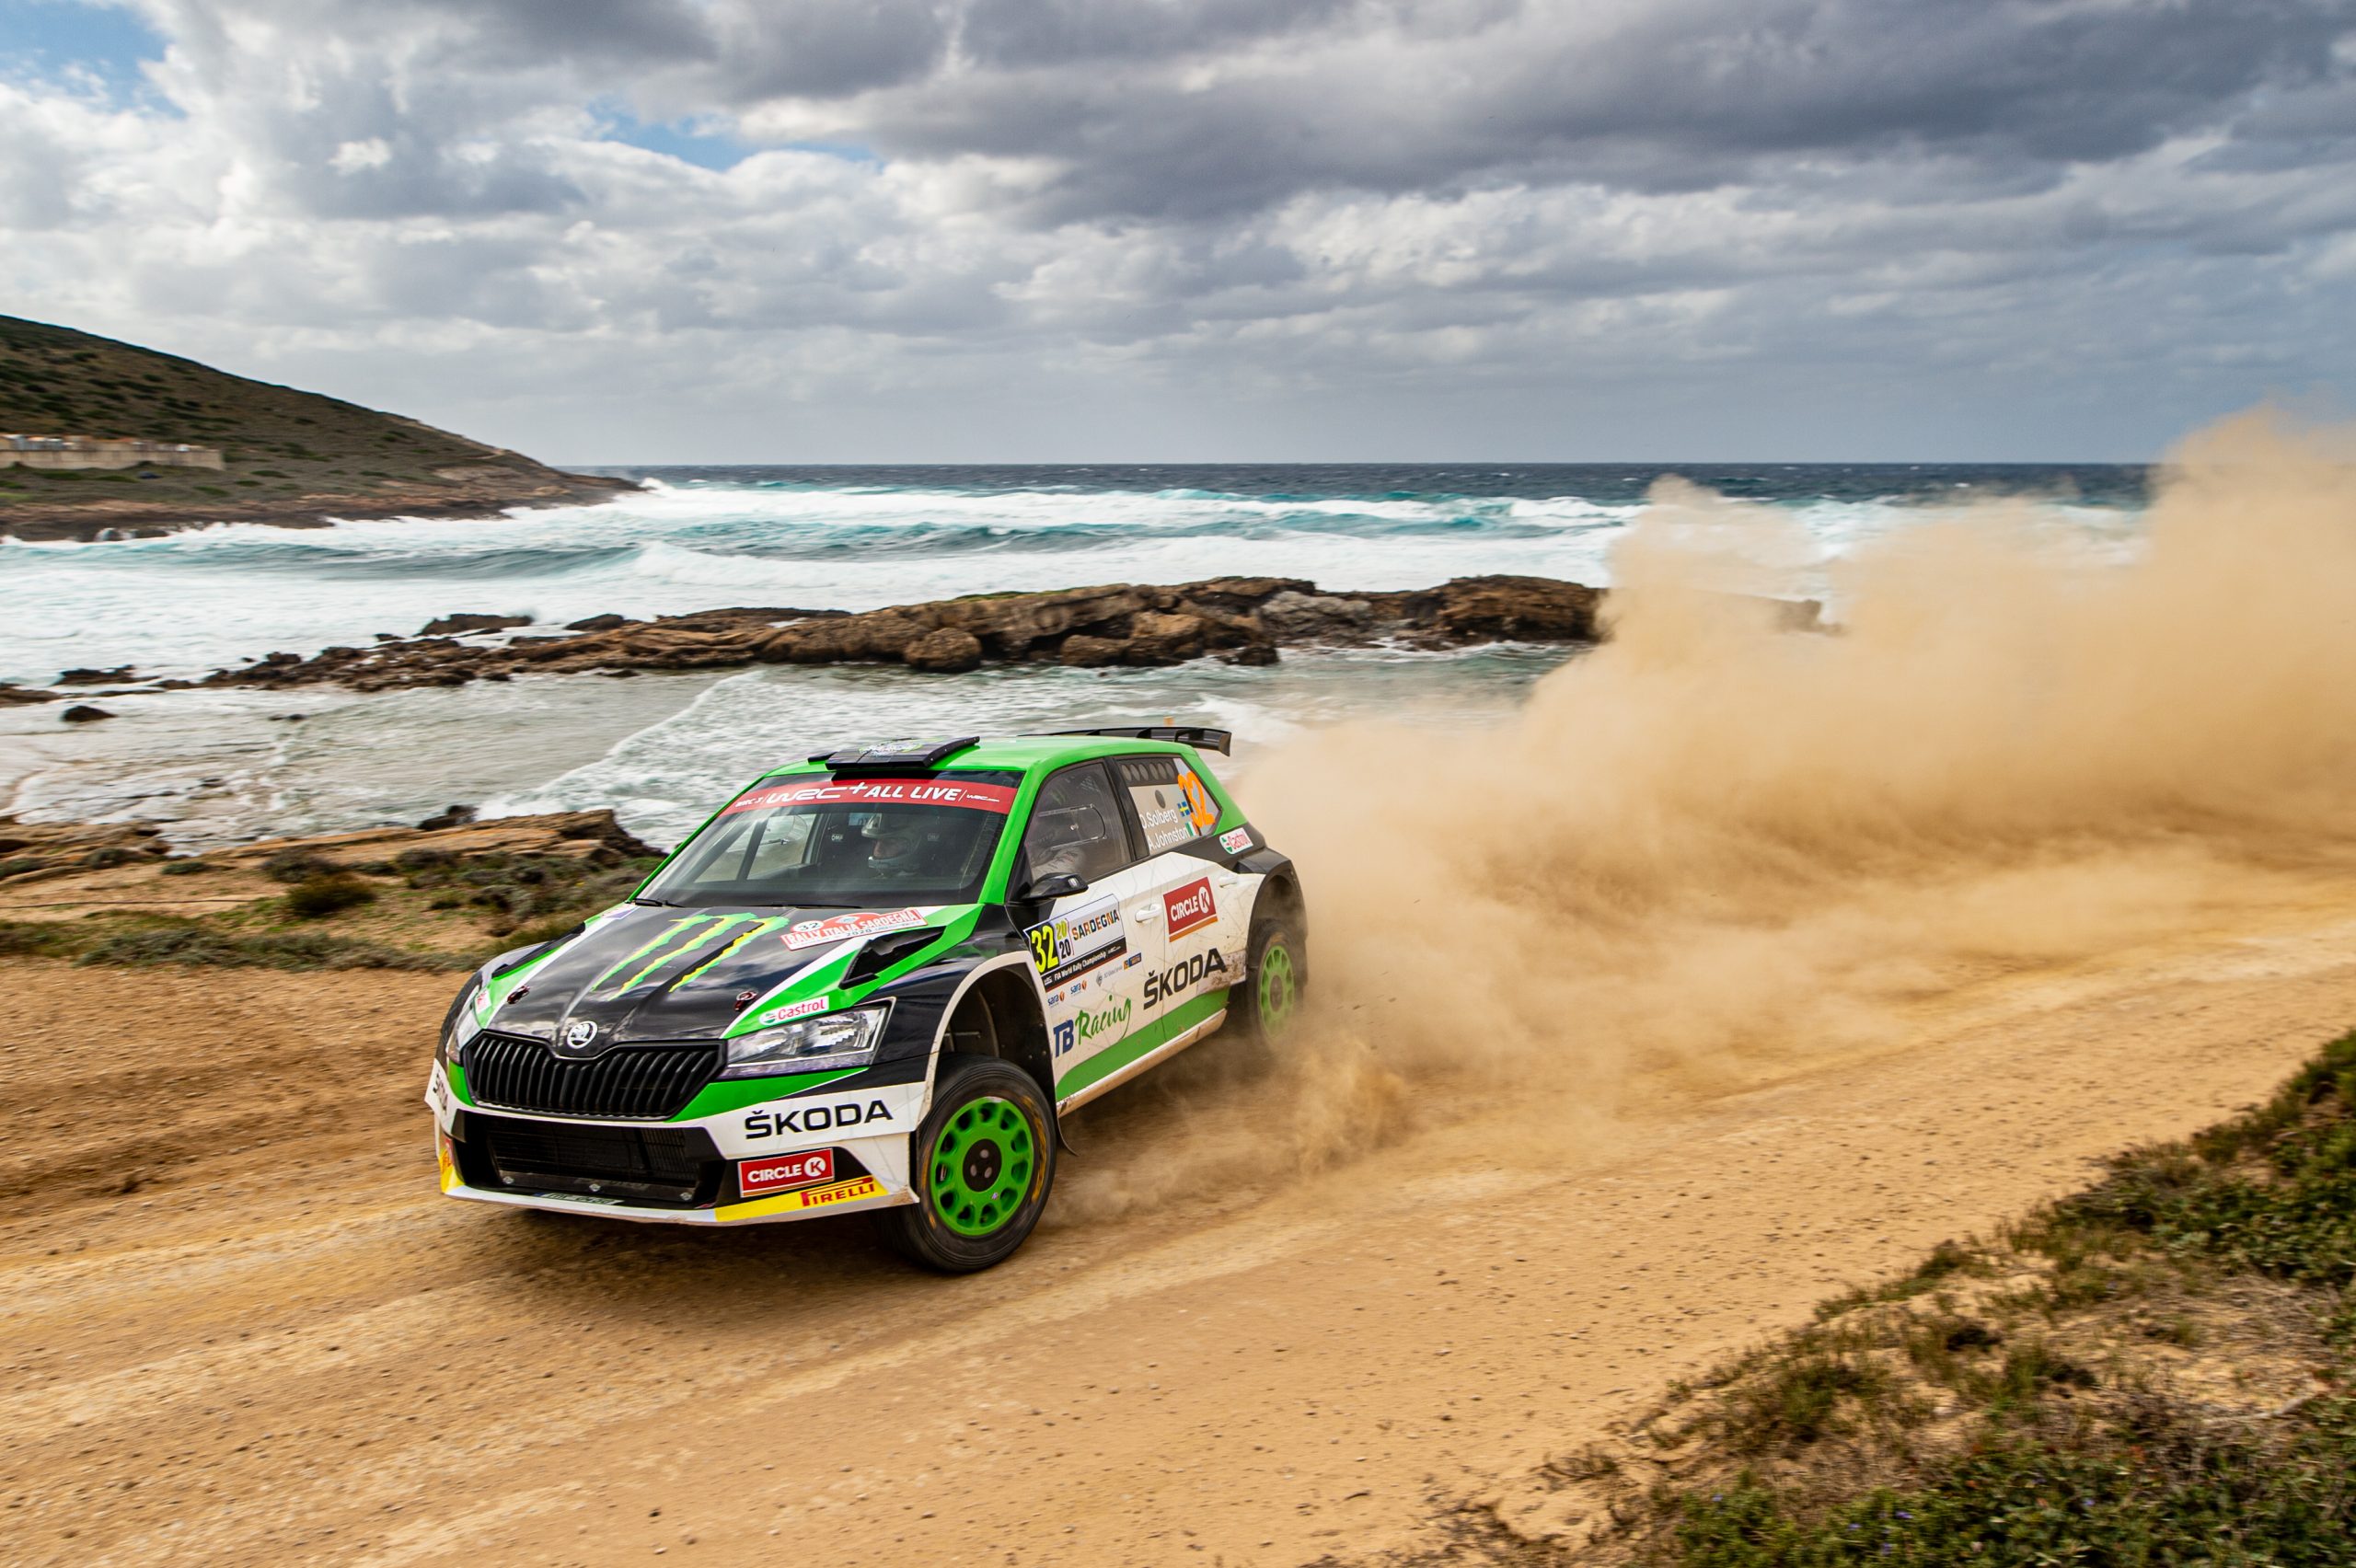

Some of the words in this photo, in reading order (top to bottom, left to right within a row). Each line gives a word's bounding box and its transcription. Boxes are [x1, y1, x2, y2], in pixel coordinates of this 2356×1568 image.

[863, 785, 904, 798] ALL
[909, 786, 962, 801] LIVE
[1178, 771, 1215, 828] 32
[1170, 895, 1199, 922] CIRCLE
[790, 928, 822, 944] RALLY
[823, 922, 860, 937] ITALIA
[860, 911, 918, 930] SARDEGNA
[798, 922, 821, 931] 32
[1055, 920, 1068, 940] 20
[1071, 909, 1120, 940] SARDEGNA
[1031, 925, 1058, 973] 32
[1059, 939, 1071, 959] 20
[1062, 966, 1072, 977] World
[1143, 948, 1229, 1010] ŠKODA
[1047, 994, 1059, 1005] sara
[1070, 983, 1081, 994] sara
[778, 999, 826, 1020] Castrol
[1053, 1019, 1074, 1058] TB
[1075, 994, 1132, 1045] Racing
[745, 1100, 894, 1139] ŠKODA
[746, 1163, 803, 1182] CIRCLE
[800, 1176, 875, 1207] PIRELLI
